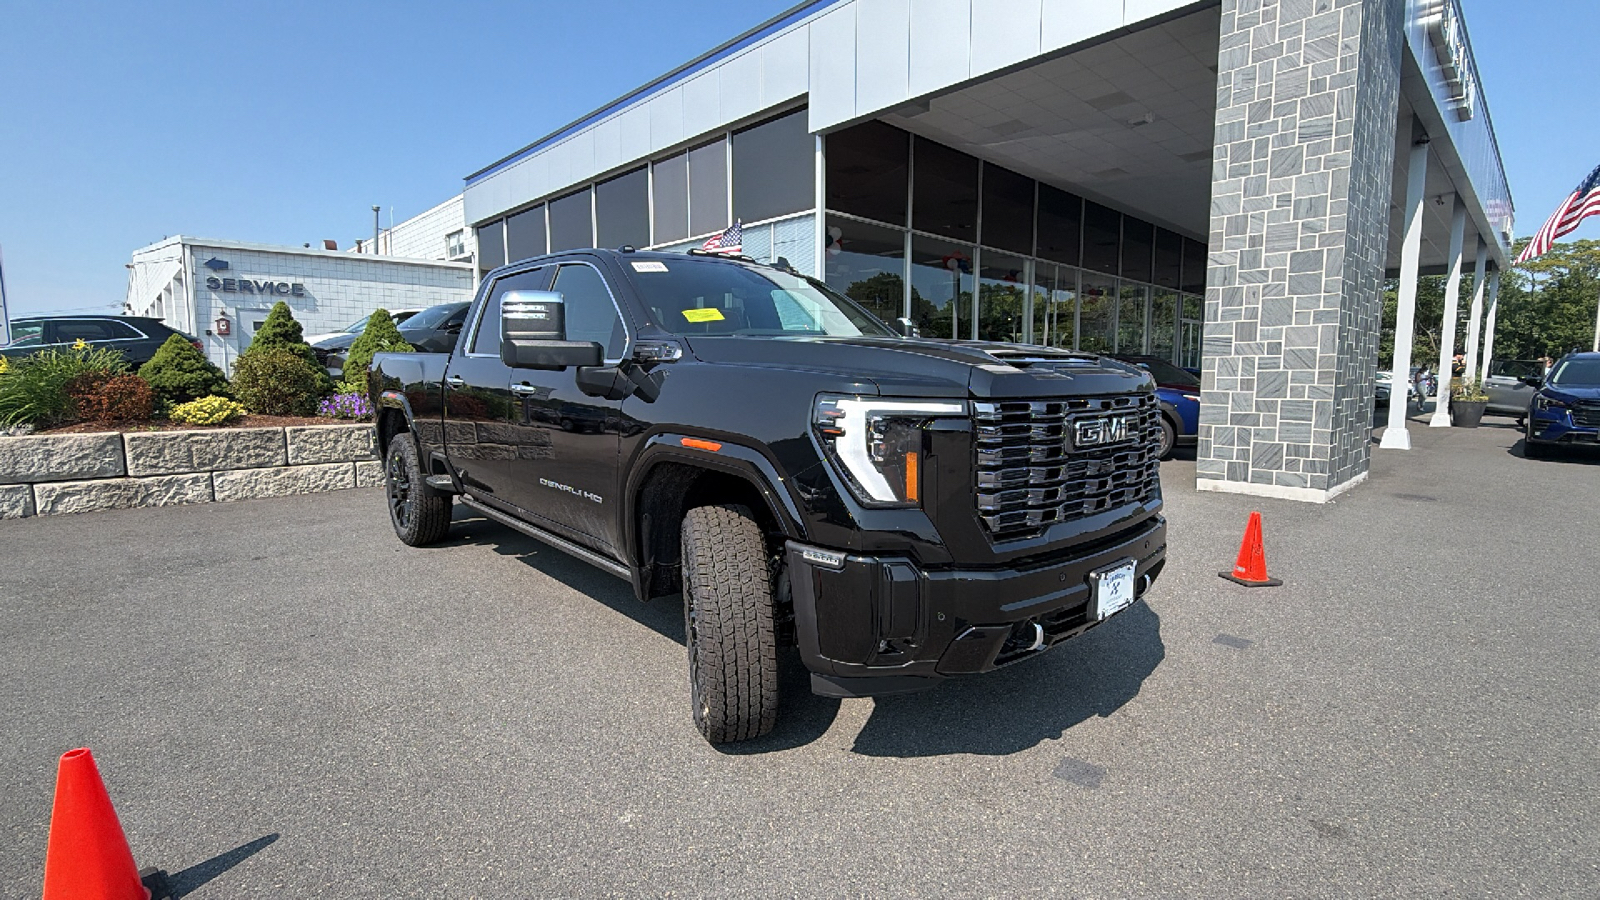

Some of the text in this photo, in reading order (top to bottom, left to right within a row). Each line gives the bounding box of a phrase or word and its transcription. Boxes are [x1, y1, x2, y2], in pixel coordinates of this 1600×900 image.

[206, 277, 304, 296] SERVICE
[1075, 417, 1140, 446] GMC
[539, 478, 603, 503] DENALI HD
